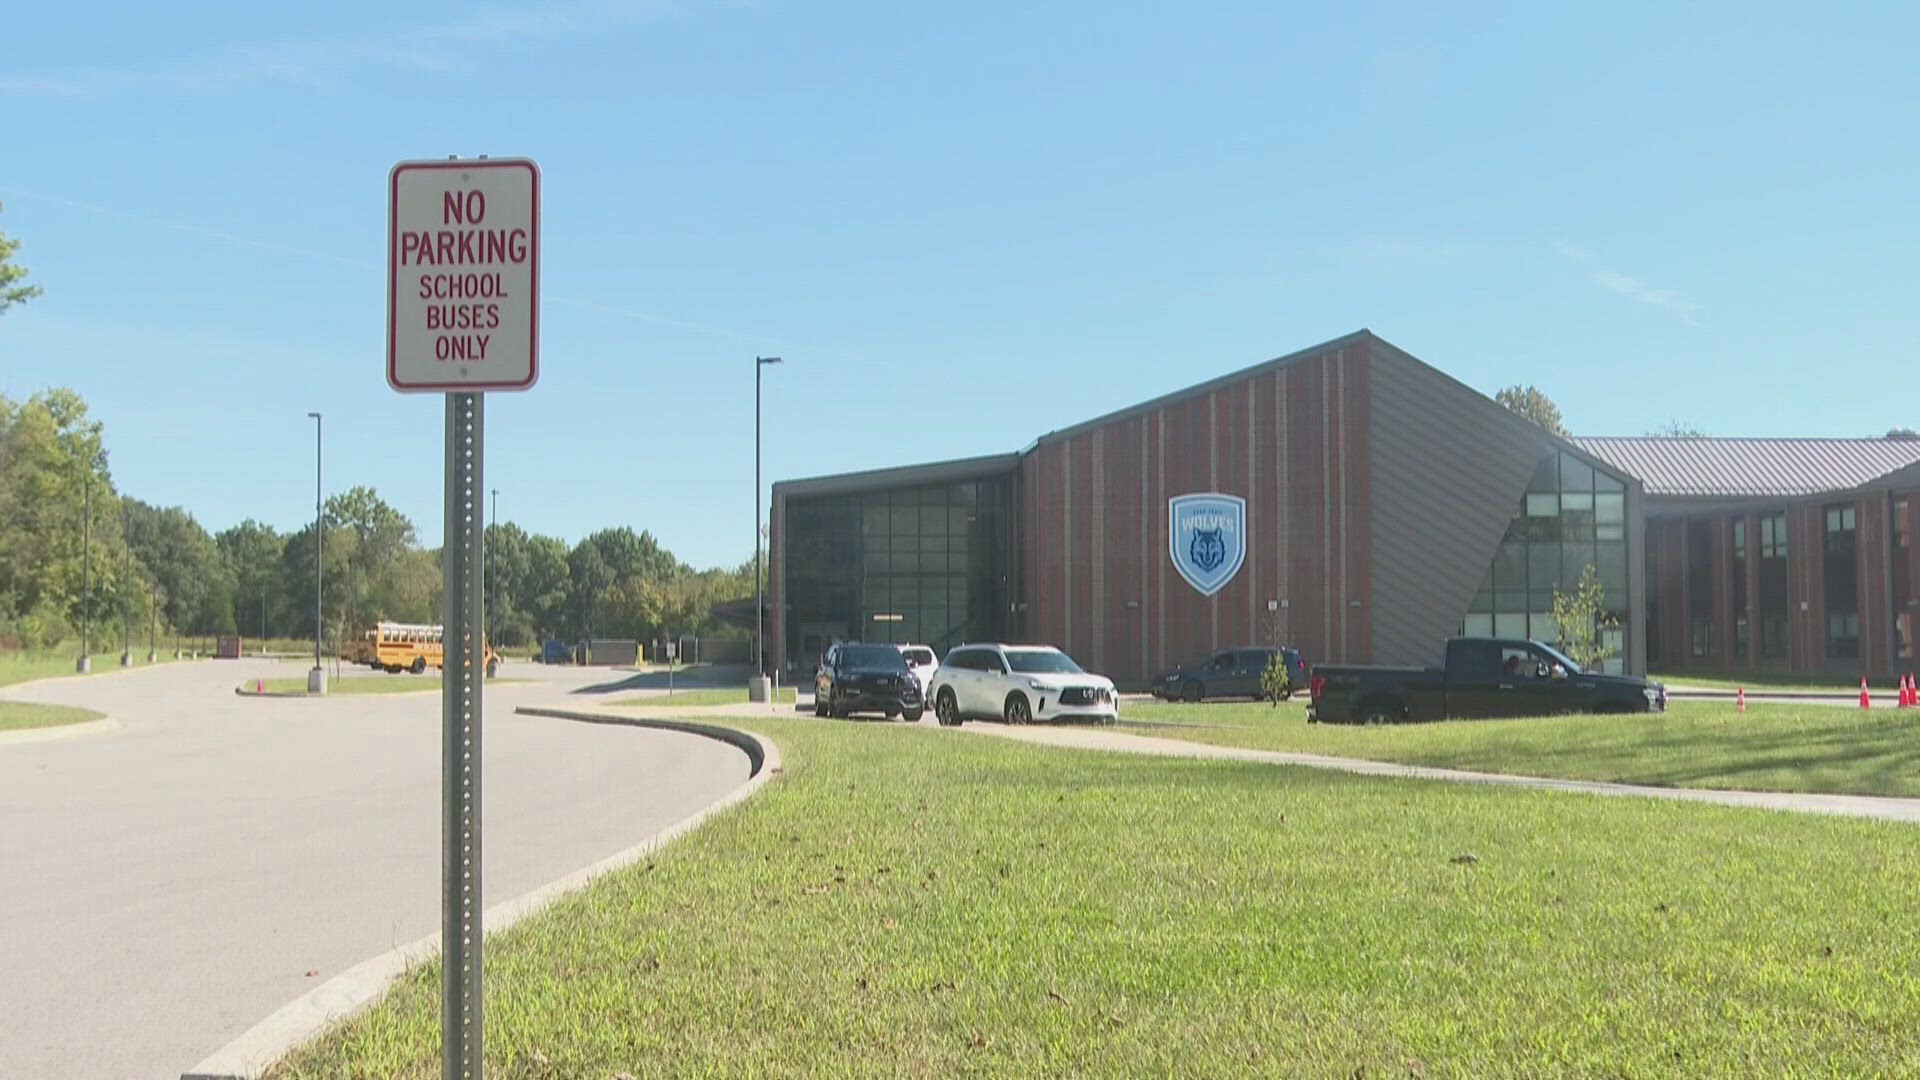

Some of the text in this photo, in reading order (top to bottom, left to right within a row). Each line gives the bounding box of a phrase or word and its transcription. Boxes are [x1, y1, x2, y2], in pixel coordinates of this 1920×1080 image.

[444, 189, 486, 225] NO
[401, 228, 527, 266] PARKING
[419, 273, 508, 299] SCHOOL
[427, 304, 500, 330] BUSES
[435, 335, 490, 361] ONLY
[1182, 516, 1233, 532] WOLVES
